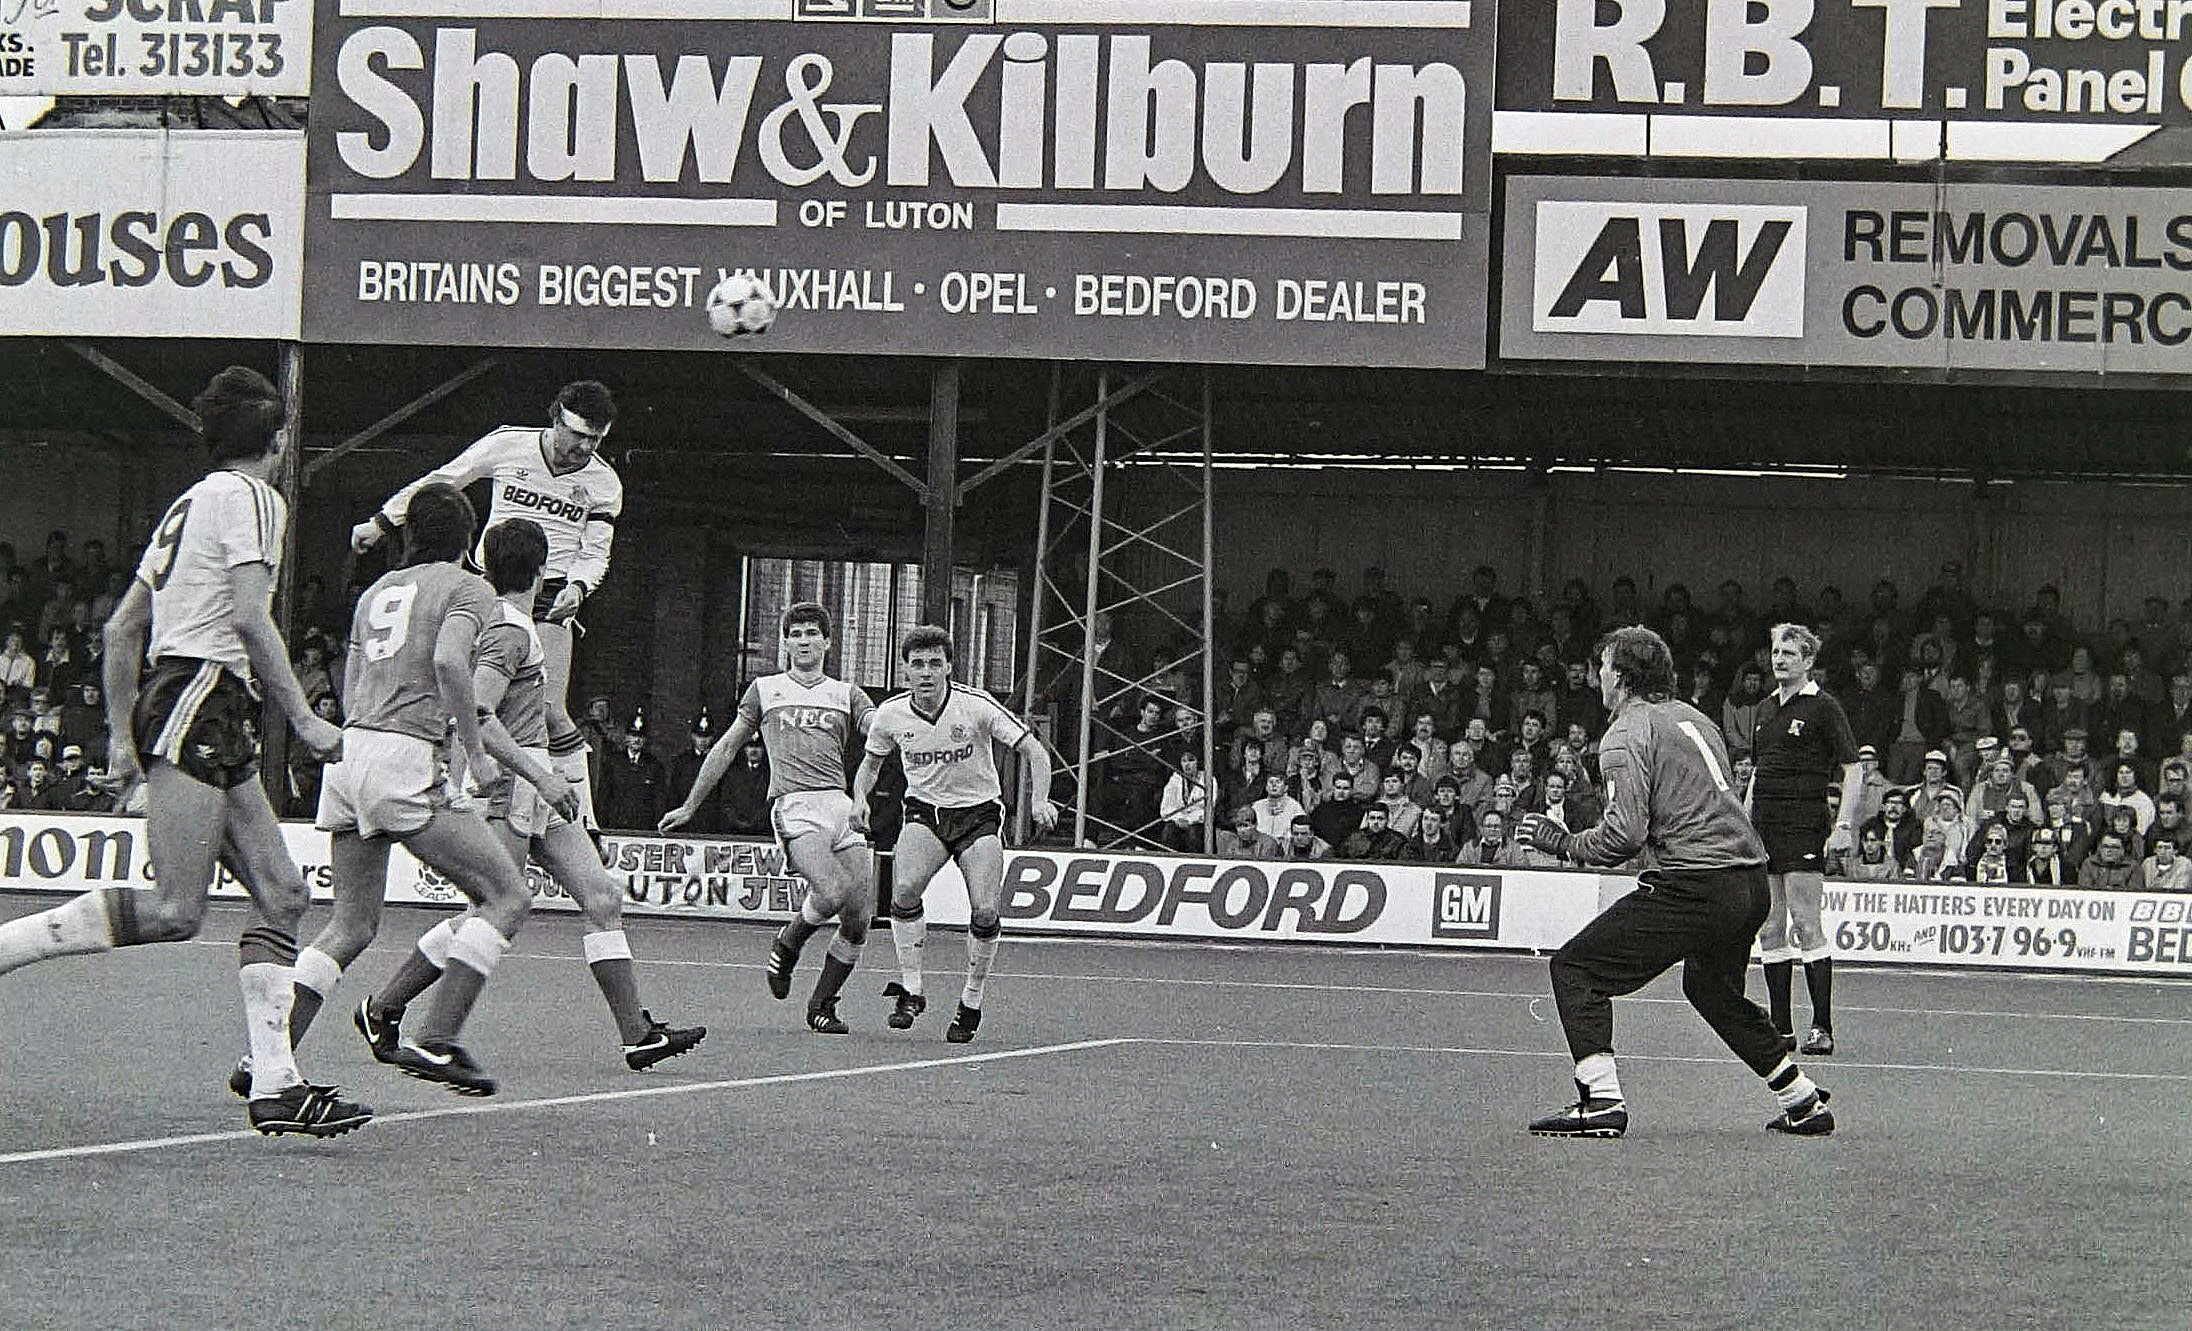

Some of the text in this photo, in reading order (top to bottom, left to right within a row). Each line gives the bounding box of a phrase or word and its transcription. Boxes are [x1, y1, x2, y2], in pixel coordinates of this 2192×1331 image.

[61, 33, 285, 77] Tel. 313133
[1986, 48, 2164, 113] Panel
[800, 201, 973, 230] OF LUTON
[1844, 210, 2192, 271] REMOVALS
[0, 211, 273, 288] ouses
[1548, 217, 1793, 321] AW
[359, 262, 1427, 325] BRITAINS BIGGEST UXHALL OPEL BEDFORD DEALER
[1842, 284, 2192, 346] COMMERC
[503, 485, 584, 522] BEDFORD
[366, 582, 418, 662] 9
[1677, 720, 1730, 791] 1
[1000, 855, 1387, 933] BEDFORD
[1442, 883, 1492, 924] GM
[1853, 892, 1888, 913] THE
[1894, 894, 1976, 915] HATTERS
[1984, 897, 2042, 917] EVERY
[2048, 899, 2083, 919] DAY
[2088, 901, 2115, 920] ON
